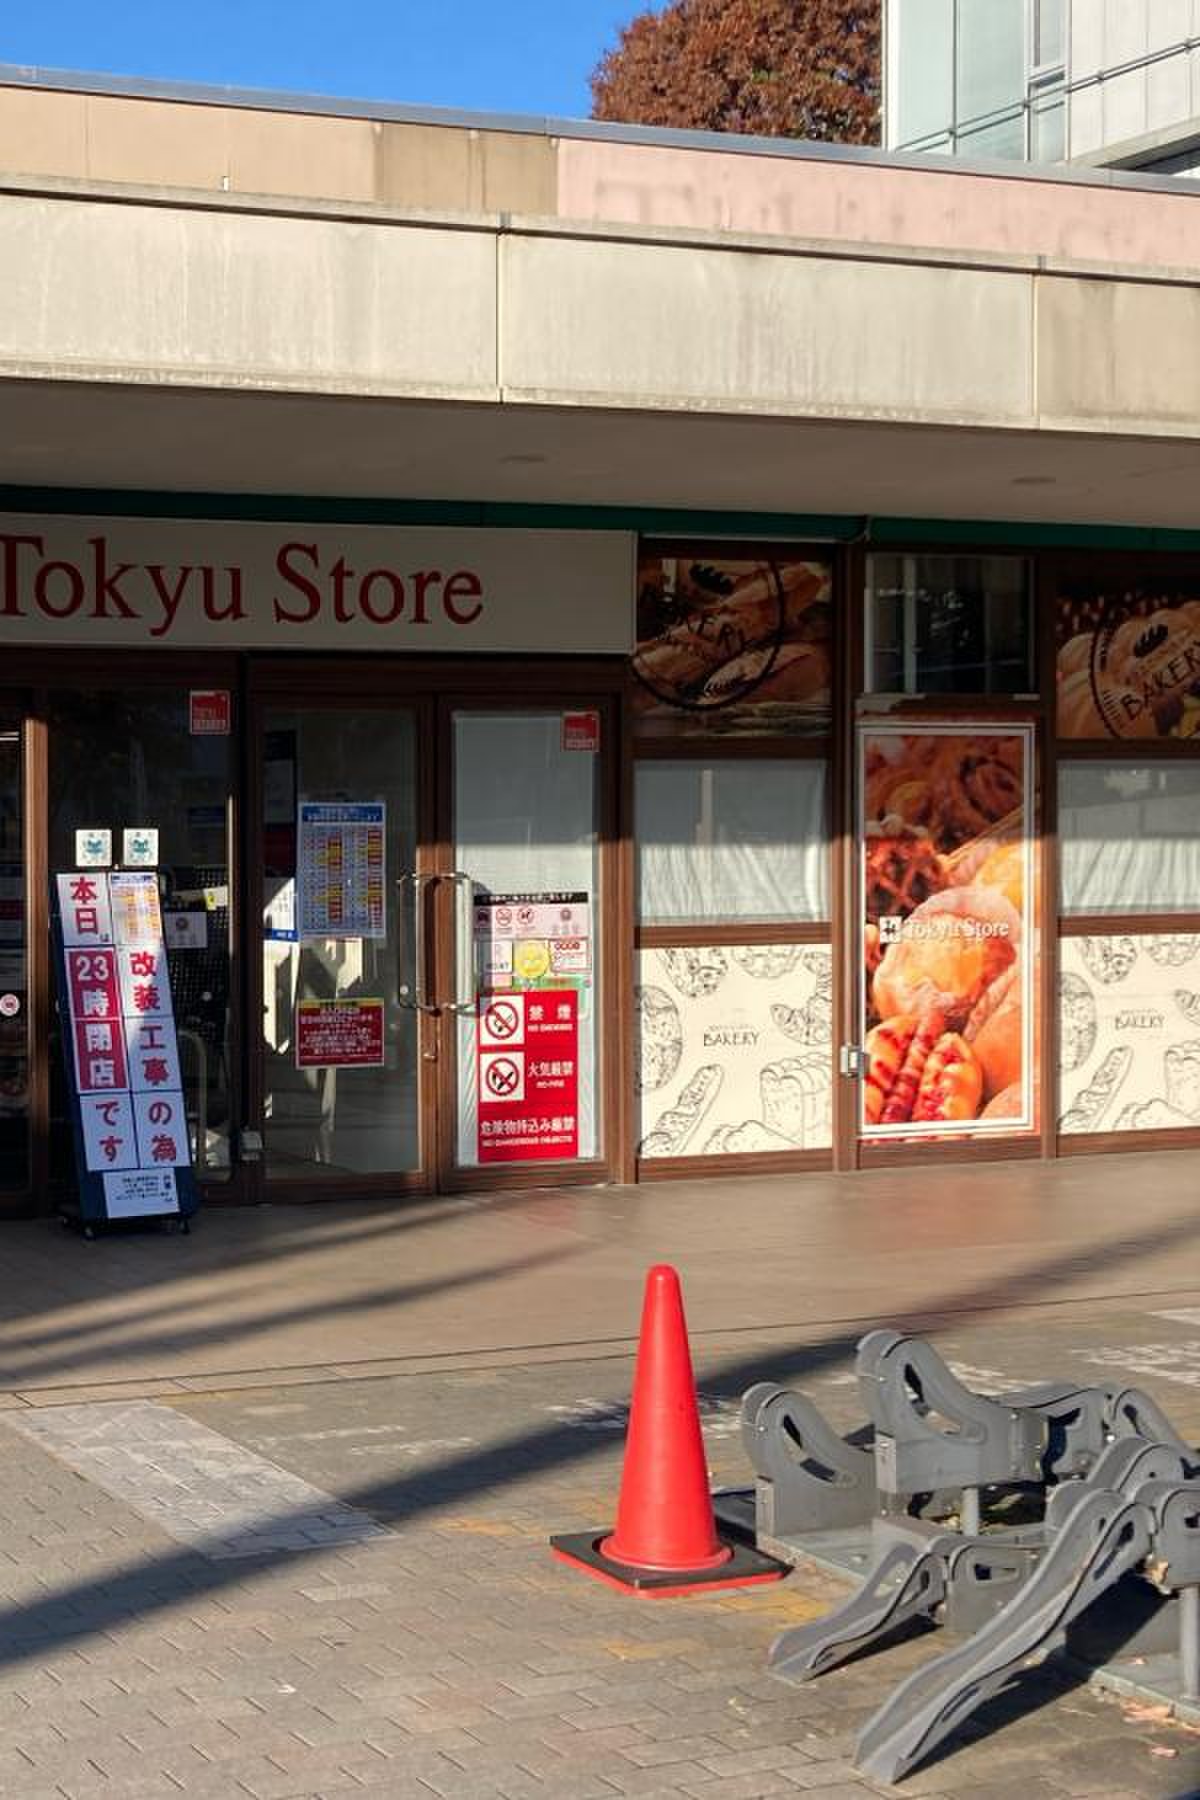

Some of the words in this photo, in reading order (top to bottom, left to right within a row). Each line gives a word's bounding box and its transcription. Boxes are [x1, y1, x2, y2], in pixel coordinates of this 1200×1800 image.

[272, 542, 484, 627] Store
[1120, 640, 1200, 722] BAKER
[963, 917, 1009, 938] Store
[1115, 1015, 1165, 1031] BAKERY
[703, 1032, 760, 1047] BAKERY
